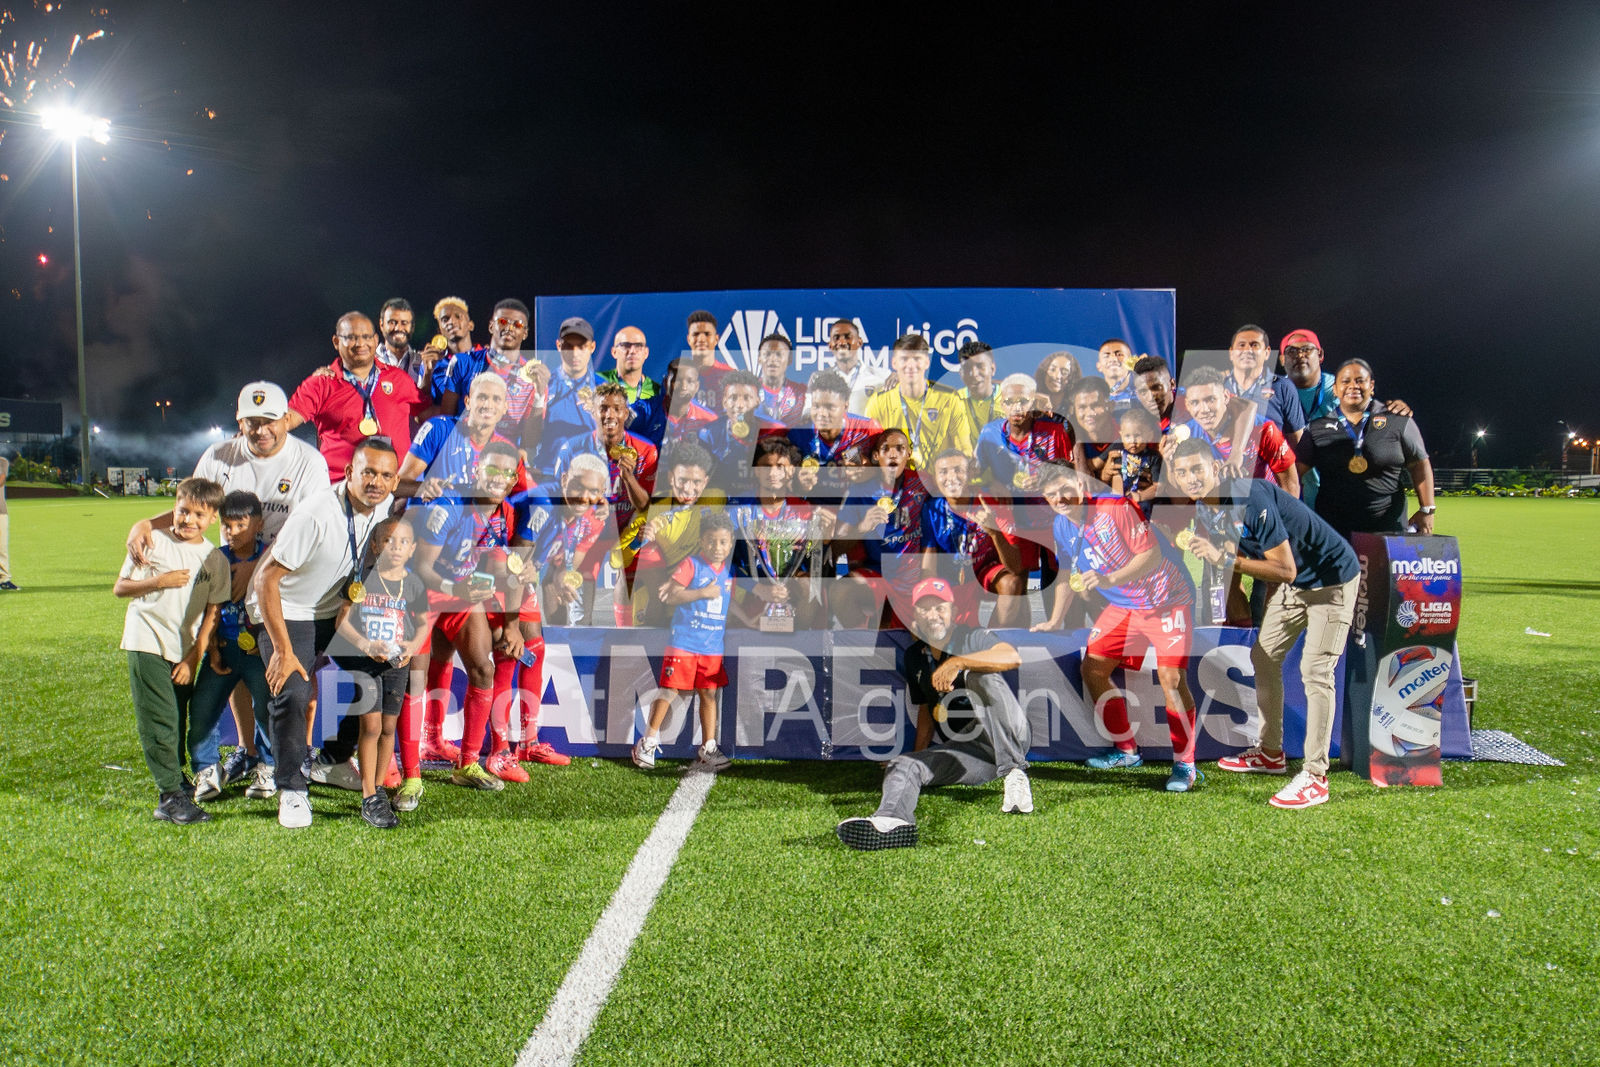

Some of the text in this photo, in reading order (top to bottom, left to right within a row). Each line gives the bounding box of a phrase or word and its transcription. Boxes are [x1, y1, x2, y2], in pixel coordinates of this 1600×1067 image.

[795, 345, 890, 371] PRM
[1391, 557, 1458, 574] molten
[1354, 554, 1370, 647] molten
[1420, 602, 1453, 613] LIGA
[367, 620, 395, 641] 85
[1161, 610, 1187, 633] 54
[1398, 662, 1450, 700] molten
[416, 644, 1256, 748] AMPENES
